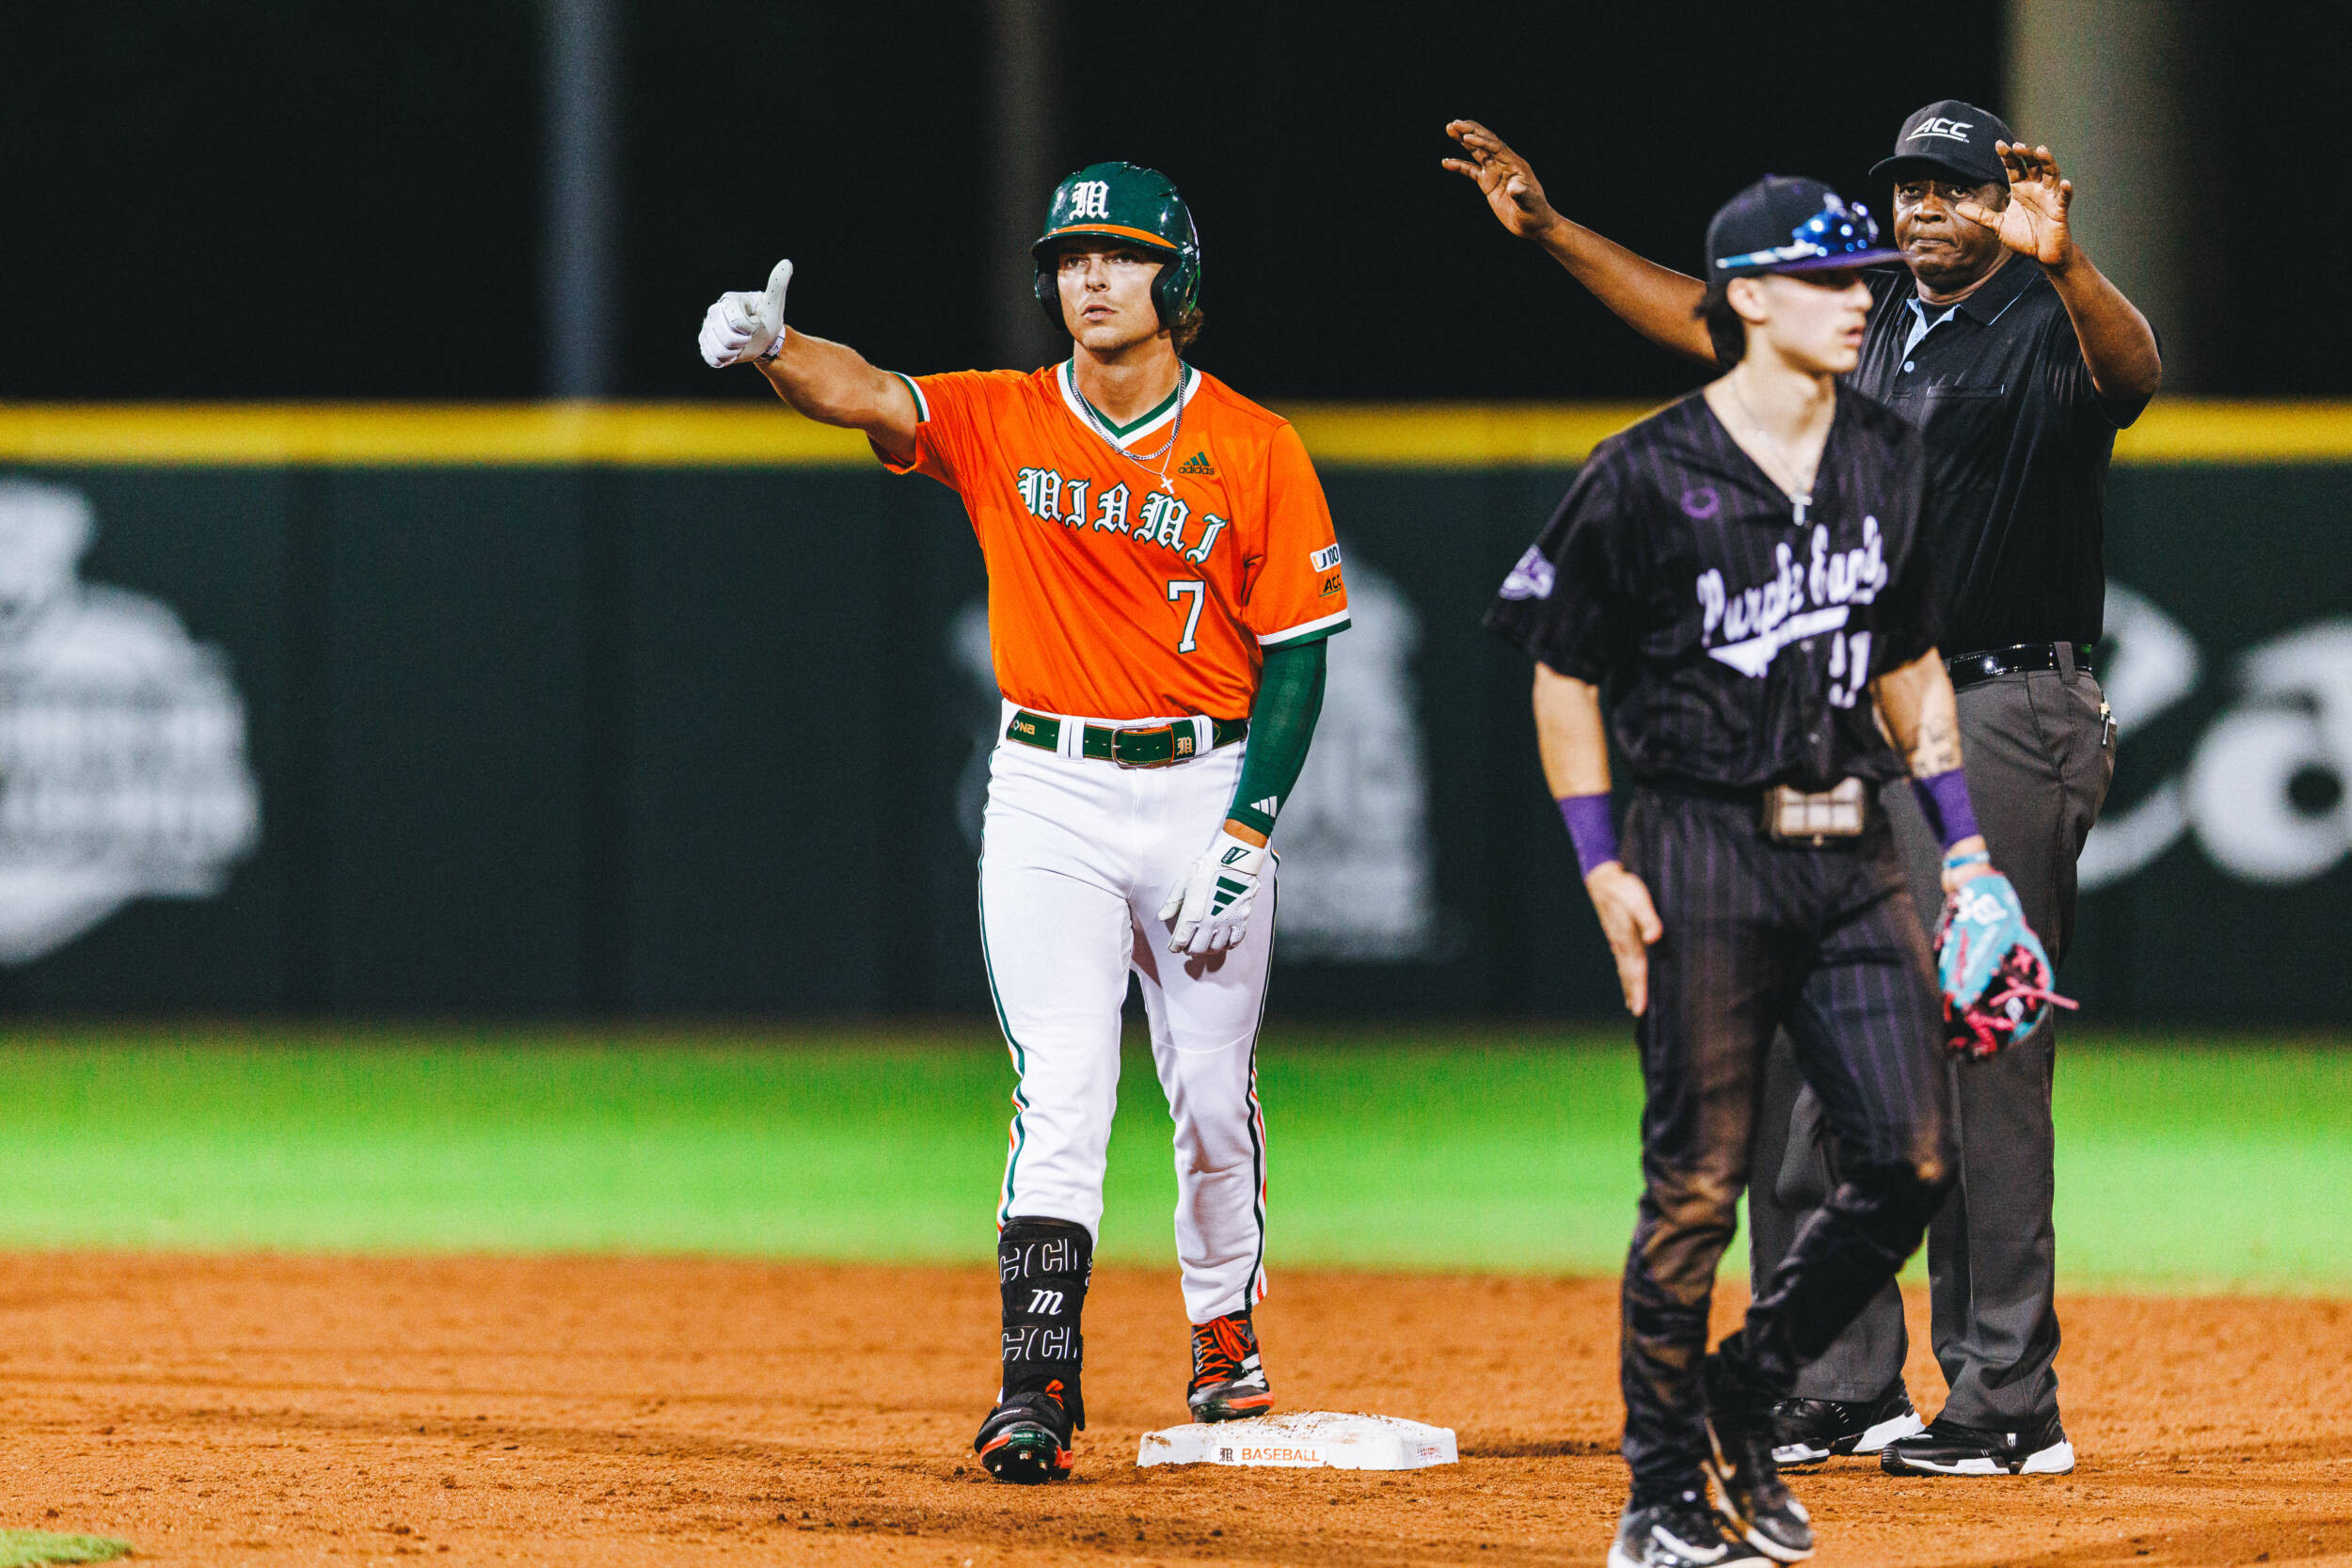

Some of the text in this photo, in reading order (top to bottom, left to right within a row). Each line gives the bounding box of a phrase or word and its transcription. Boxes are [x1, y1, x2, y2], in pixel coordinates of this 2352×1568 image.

[1911, 117, 1974, 139] ACC
[1069, 180, 1109, 221] M
[1178, 465, 1216, 476] adidas
[1017, 467, 1228, 563] MIAMI
[1324, 575, 1342, 593] ACC
[1168, 579, 1206, 654] 7
[1176, 736, 1193, 756] M
[1026, 1289, 1064, 1316] m
[1218, 1447, 1320, 1463] M BASEBALL
